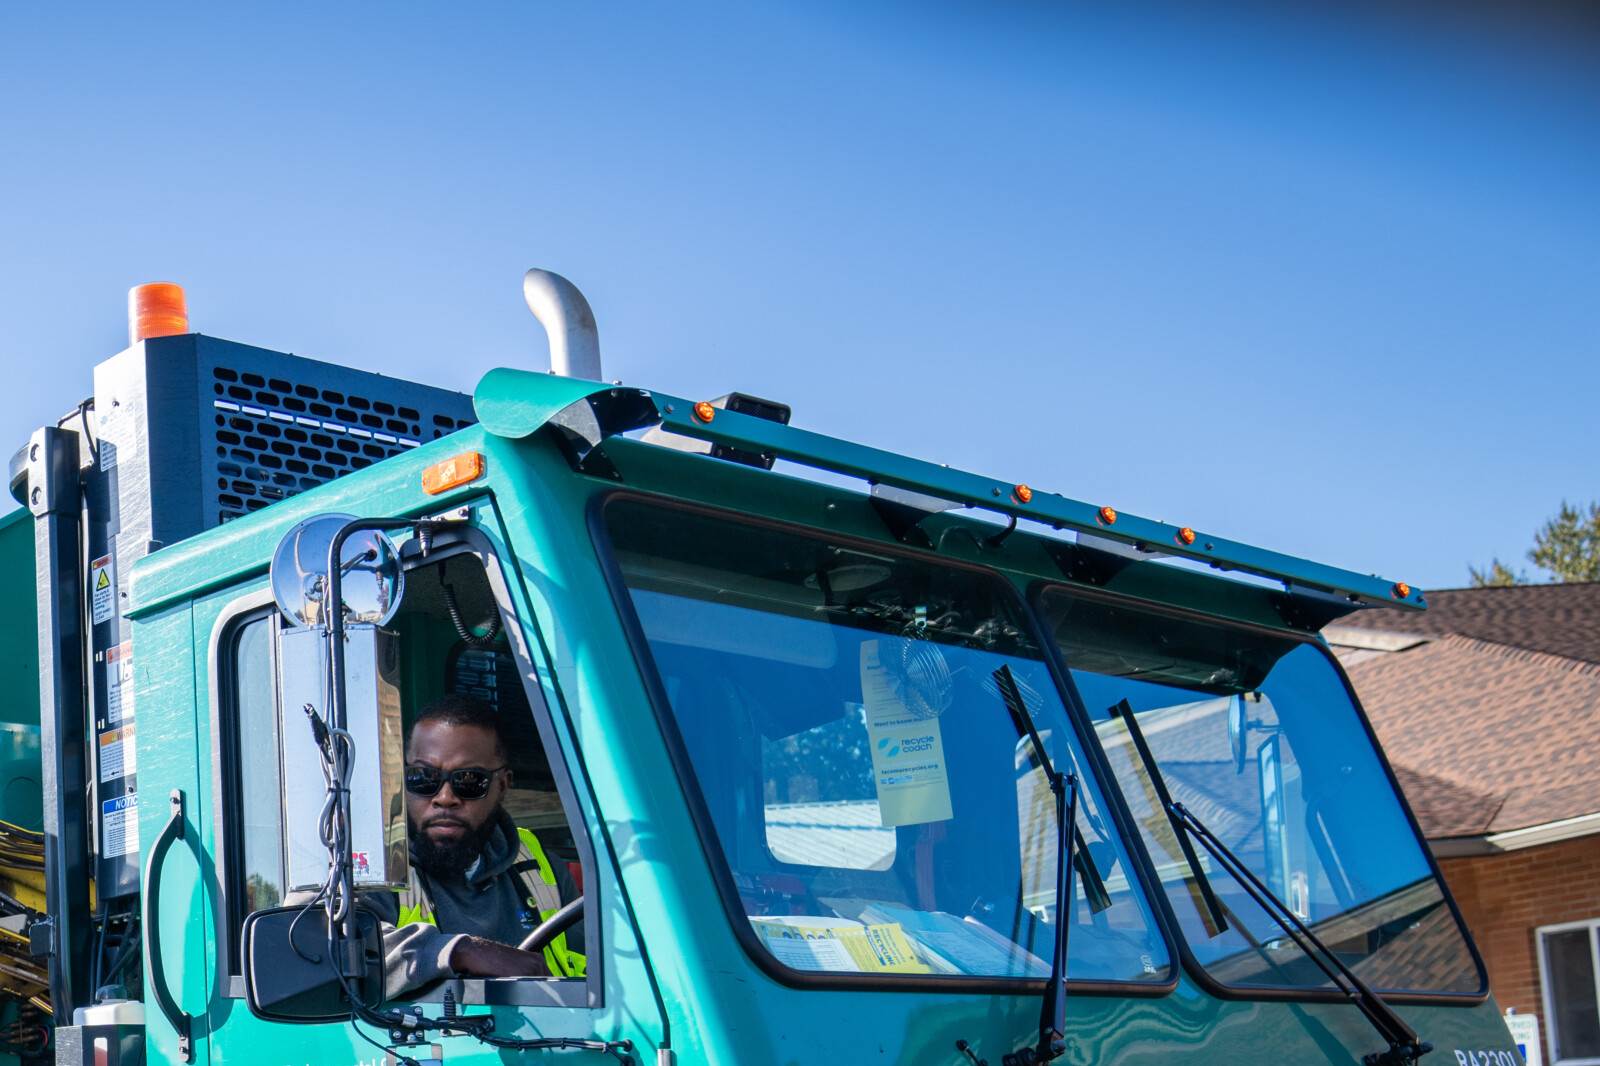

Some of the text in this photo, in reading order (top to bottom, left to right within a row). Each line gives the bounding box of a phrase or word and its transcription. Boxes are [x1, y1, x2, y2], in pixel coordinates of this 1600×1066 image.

[117, 726, 135, 740] WARNI
[901, 735, 935, 747] recycle
[902, 743, 933, 753] coach
[881, 763, 939, 775] tacomarecycles.org
[115, 795, 138, 810] NOTIC
